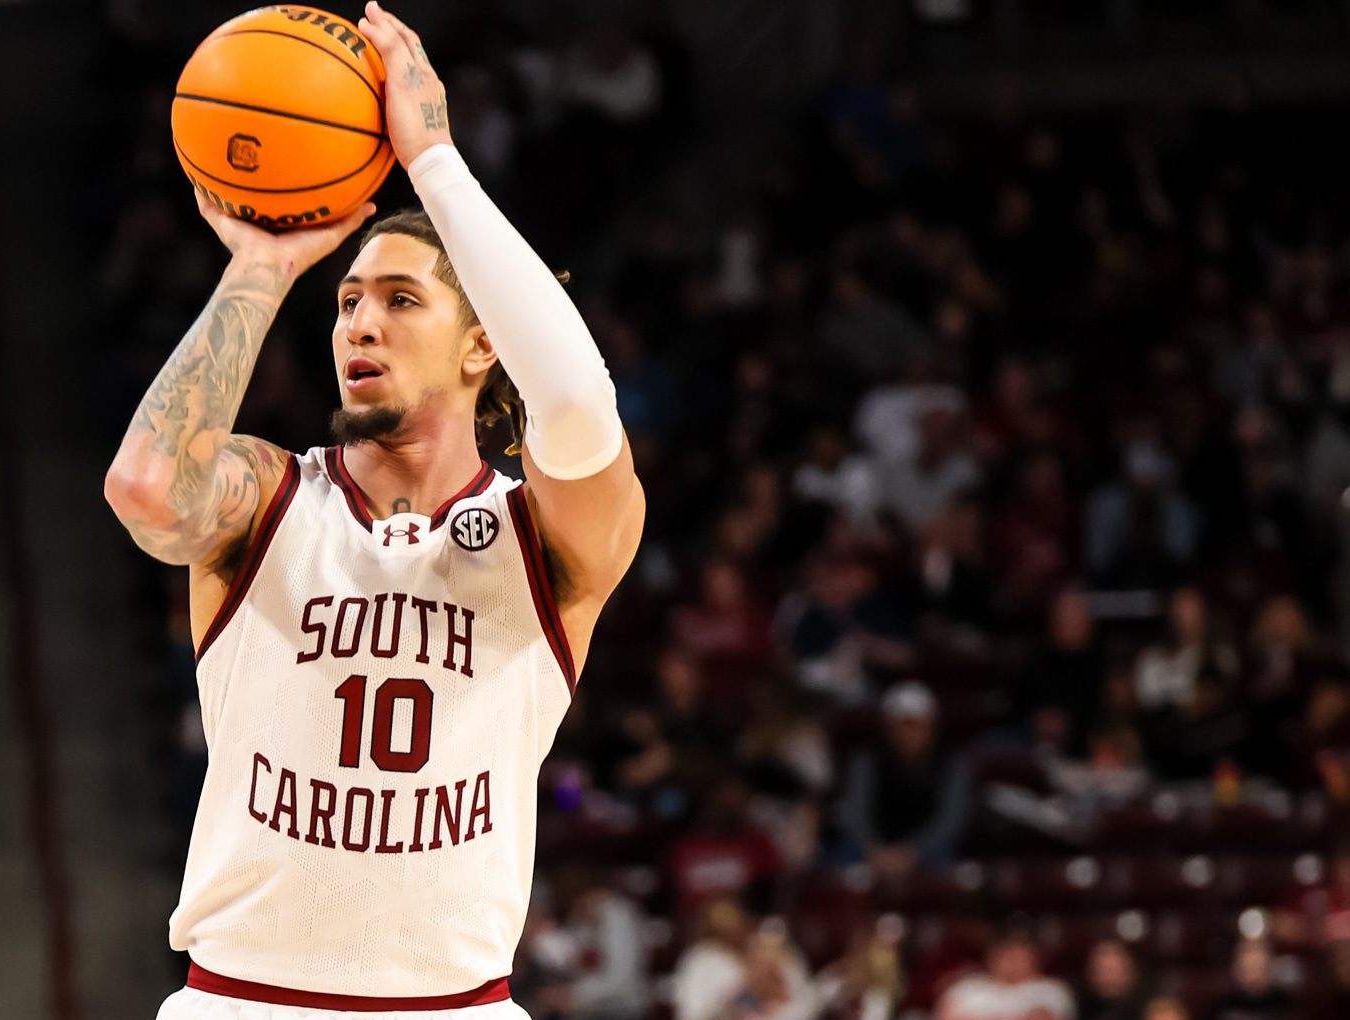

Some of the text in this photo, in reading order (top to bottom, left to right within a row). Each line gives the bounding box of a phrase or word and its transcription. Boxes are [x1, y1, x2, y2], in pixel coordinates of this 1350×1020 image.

[455, 509, 497, 549] SEC
[297, 592, 475, 678] SOUTH
[335, 674, 434, 773] 10
[248, 752, 493, 853] CAROLINA
